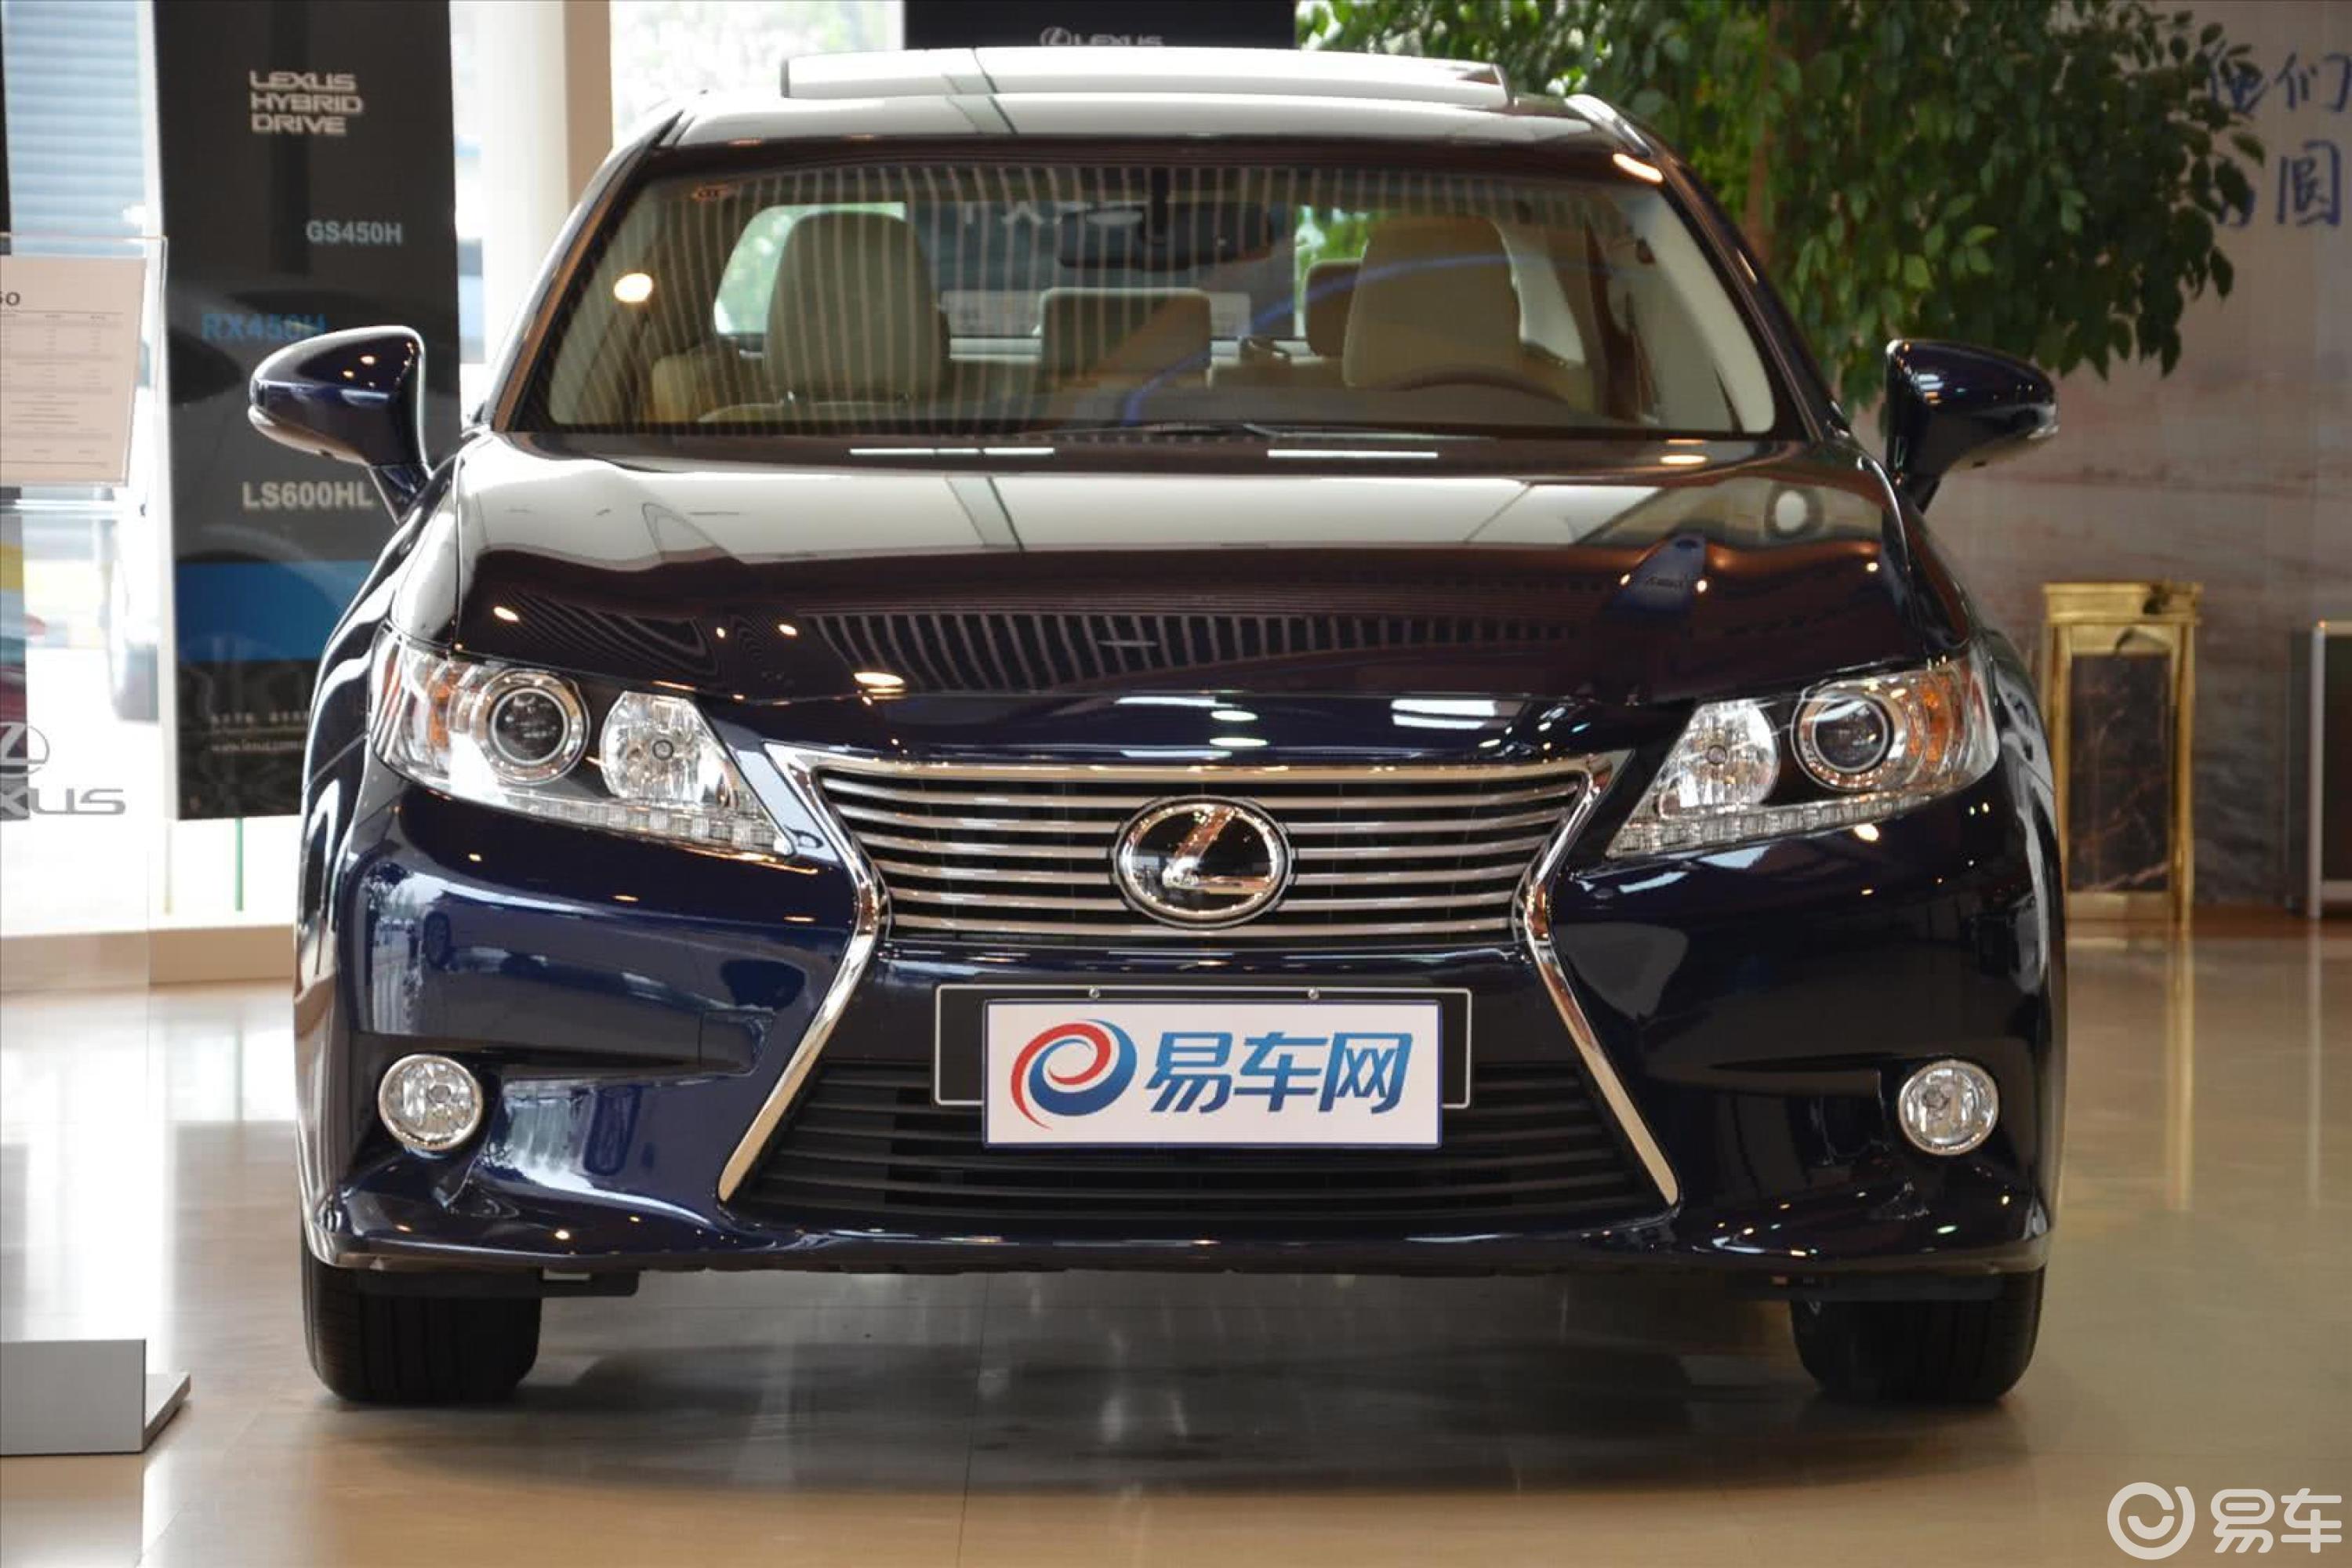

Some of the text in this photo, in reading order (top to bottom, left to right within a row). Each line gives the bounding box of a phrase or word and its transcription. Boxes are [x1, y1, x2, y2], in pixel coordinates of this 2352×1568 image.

[249, 70, 358, 92] LEXUS
[250, 92, 365, 113] HYBRID
[251, 113, 347, 136] DRIVE
[306, 220, 404, 245] GS450H
[241, 481, 374, 509] LS600HL
[1145, 1030, 1414, 1115] 易车网
